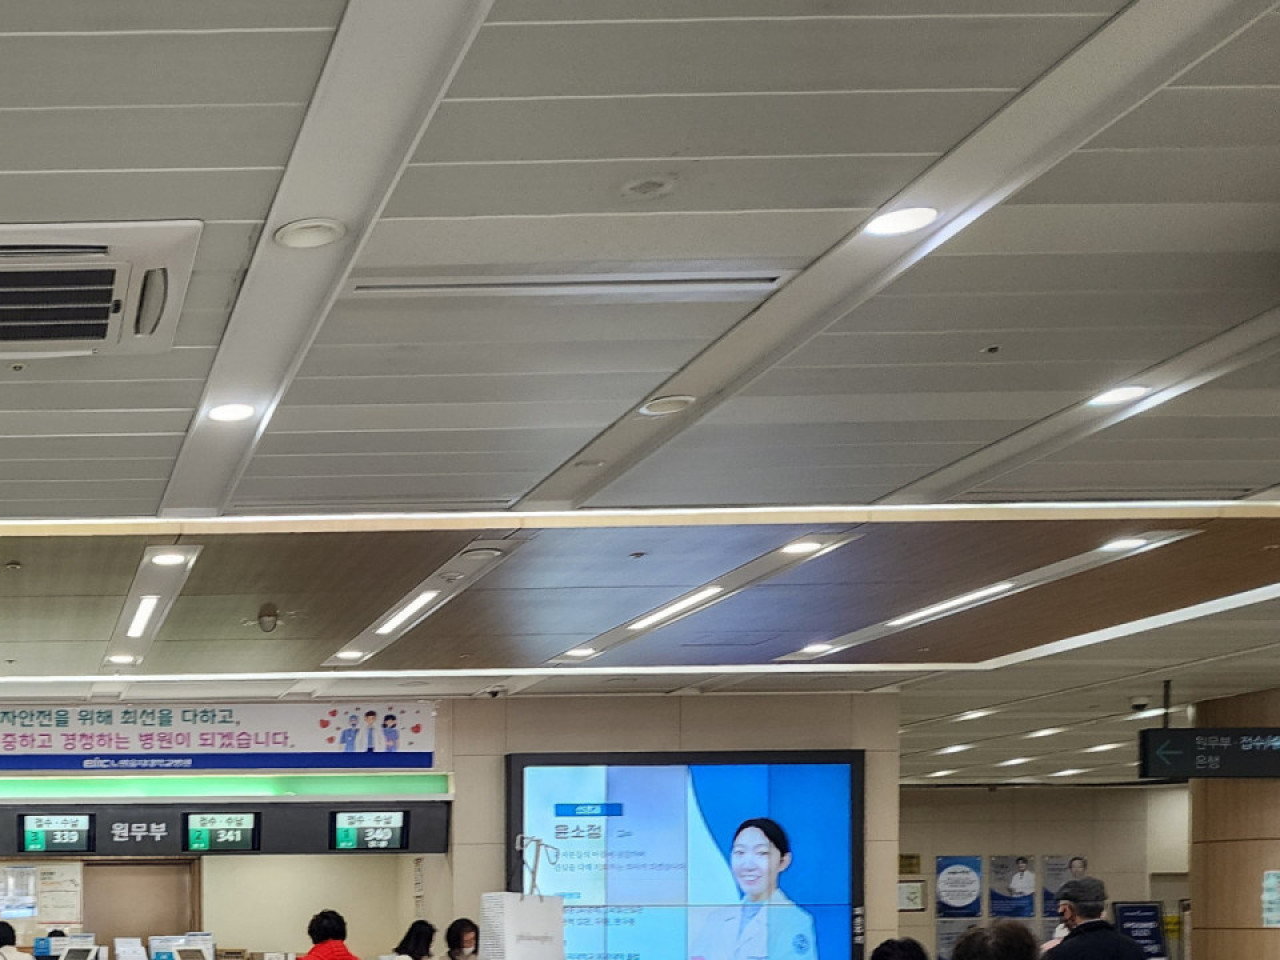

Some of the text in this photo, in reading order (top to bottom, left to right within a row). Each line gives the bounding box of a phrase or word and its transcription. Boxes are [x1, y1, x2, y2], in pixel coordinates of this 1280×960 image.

[77, 709, 113, 726] 위해
[120, 709, 173, 726] 최선을
[181, 709, 240, 726] 다하고,
[61, 732, 129, 750] 경청하는
[138, 732, 191, 749] 병원이
[198, 731, 295, 749] 되겠습니다.
[111, 823, 168, 842] 원무부
[194, 830, 241, 842] 2 341
